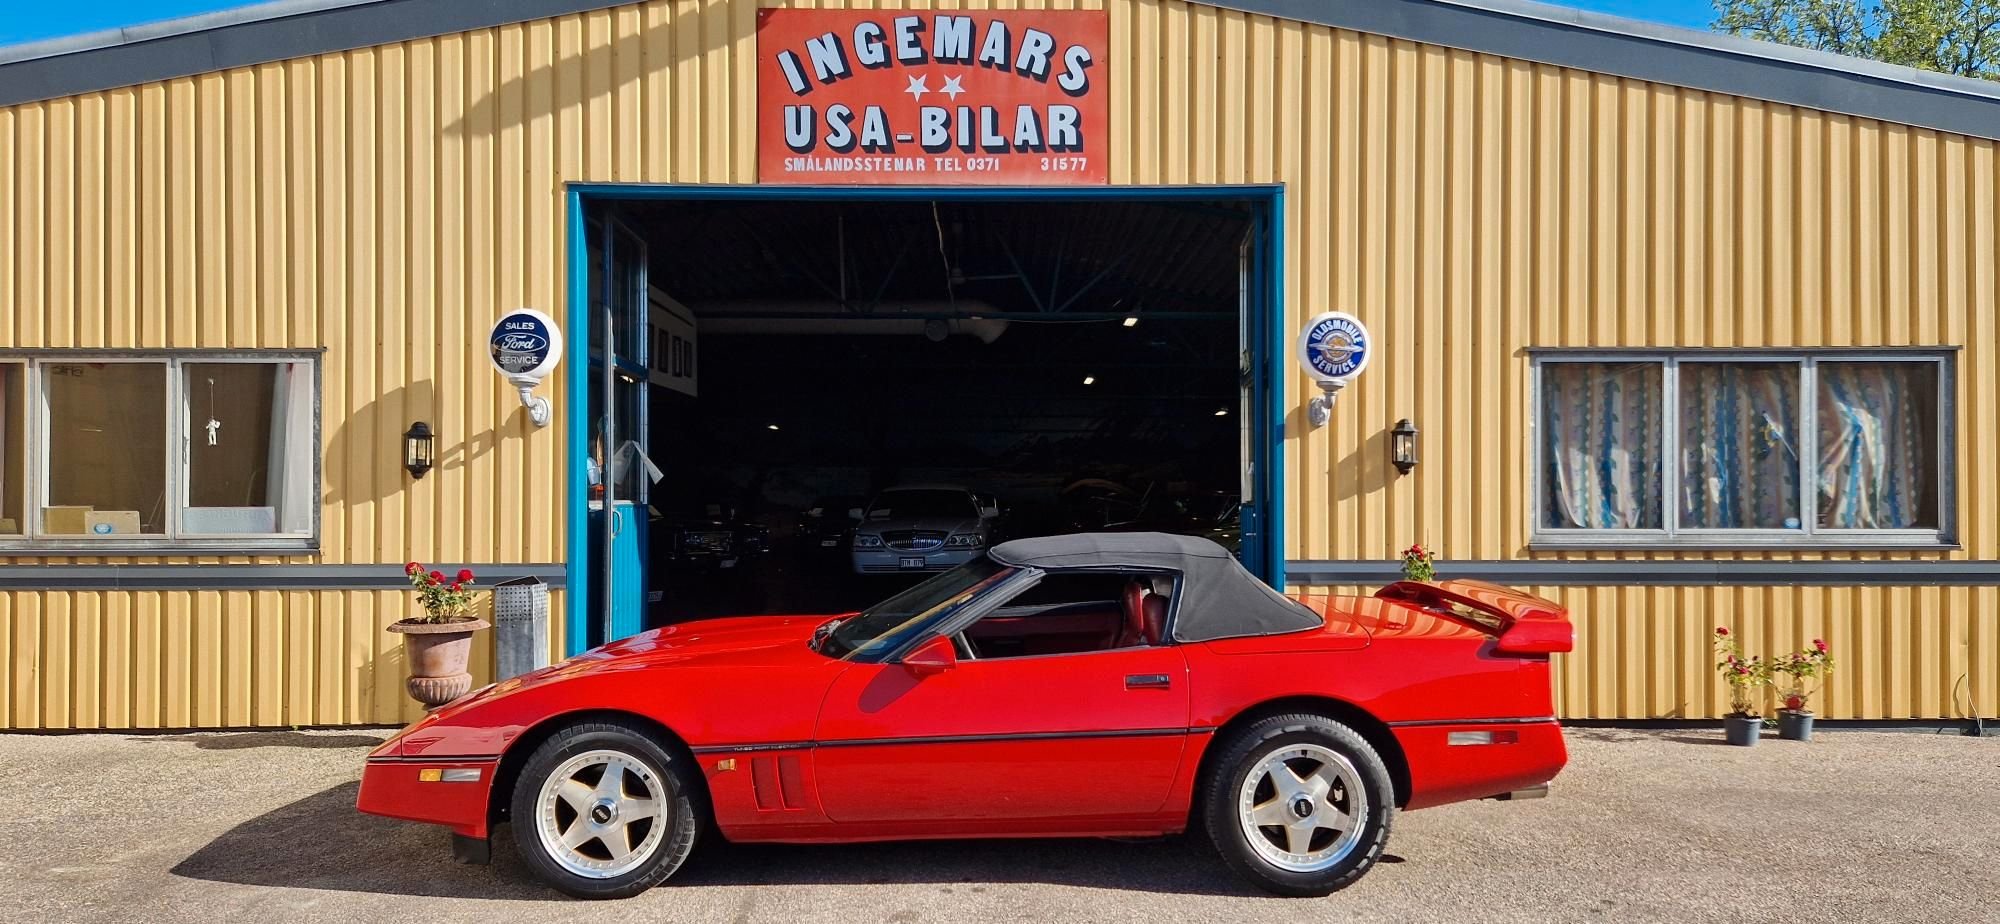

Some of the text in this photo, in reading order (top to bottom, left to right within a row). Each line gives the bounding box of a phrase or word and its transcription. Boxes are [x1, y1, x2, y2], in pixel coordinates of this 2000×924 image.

[777, 15, 1093, 97] INGEMARS
[784, 104, 1083, 153] USA-BILAR
[784, 155, 1088, 172] SMÅLANDSSTENAR TEL 0371 31577
[505, 322, 535, 330] SALES
[1311, 319, 1363, 344] OLDSMOBILE
[501, 334, 536, 350] Ford
[499, 356, 539, 365] SERVICE
[1312, 355, 1356, 375] SERVICE
